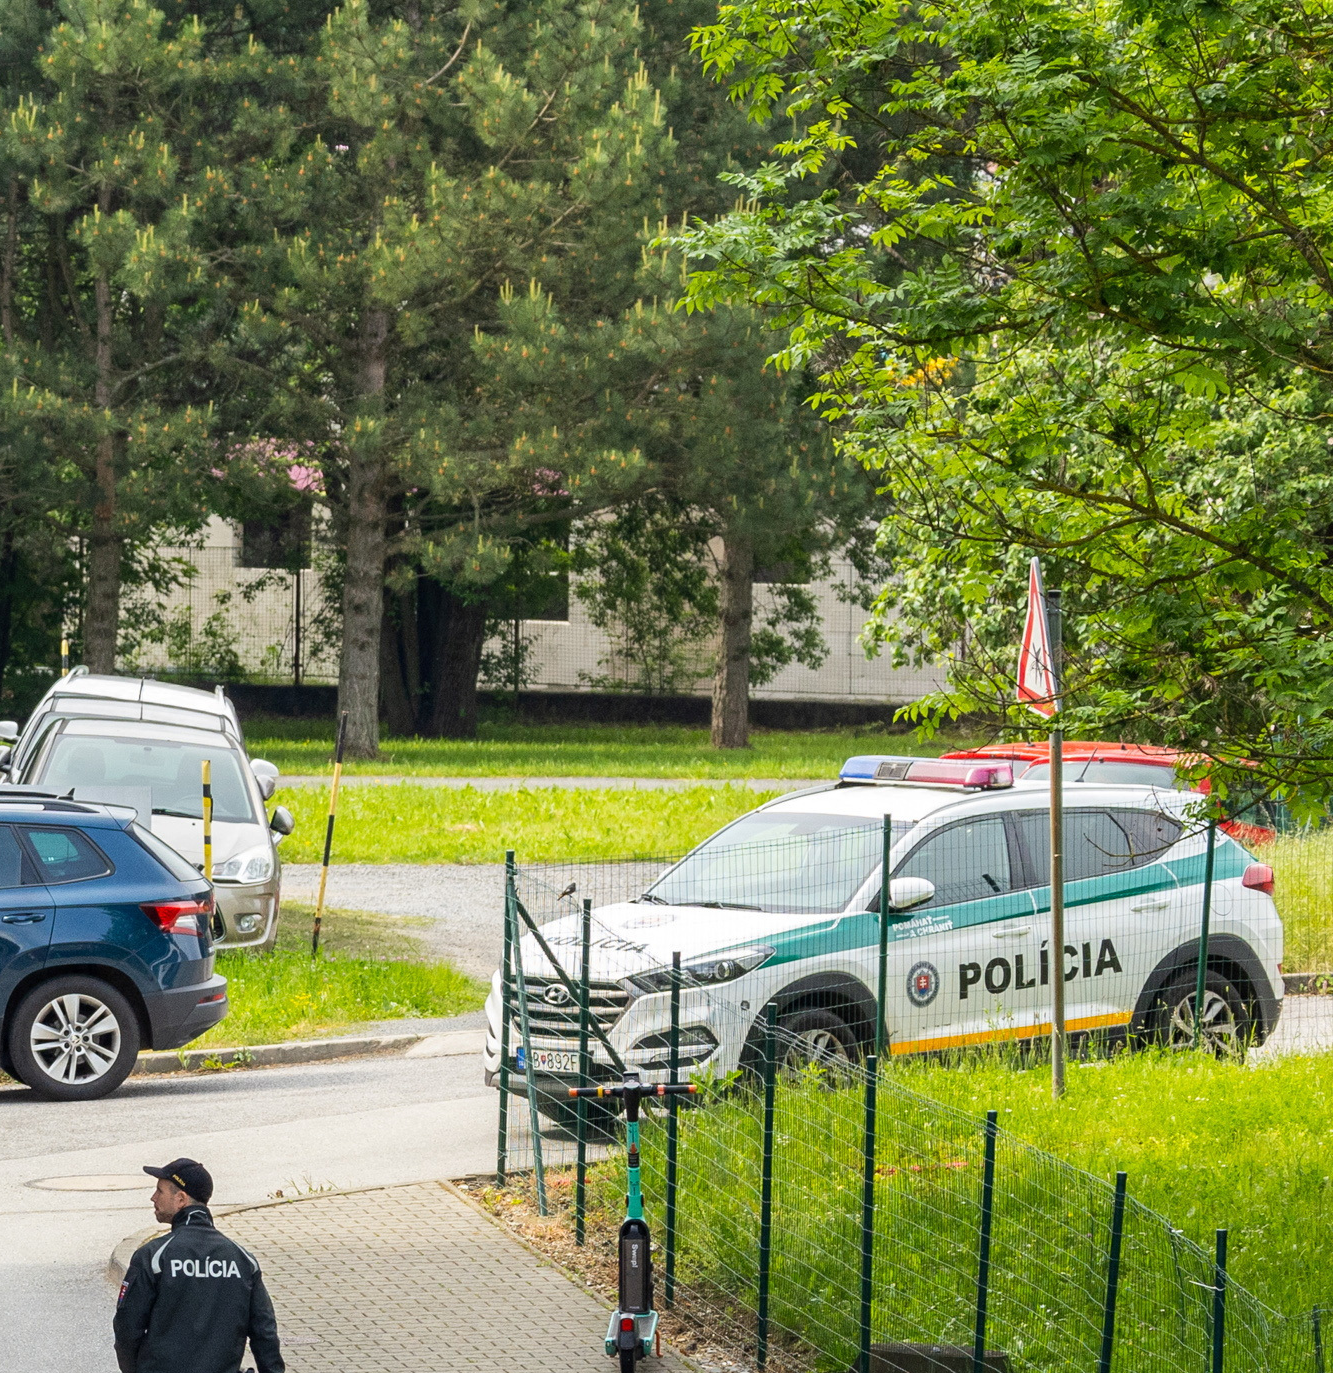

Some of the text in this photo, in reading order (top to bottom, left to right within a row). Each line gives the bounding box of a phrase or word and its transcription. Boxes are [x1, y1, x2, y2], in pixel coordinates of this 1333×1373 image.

[959, 938, 1123, 1000] POLÍCIA
[547, 1052, 577, 1071] 892F
[170, 1255, 242, 1279] POLÍCIA
